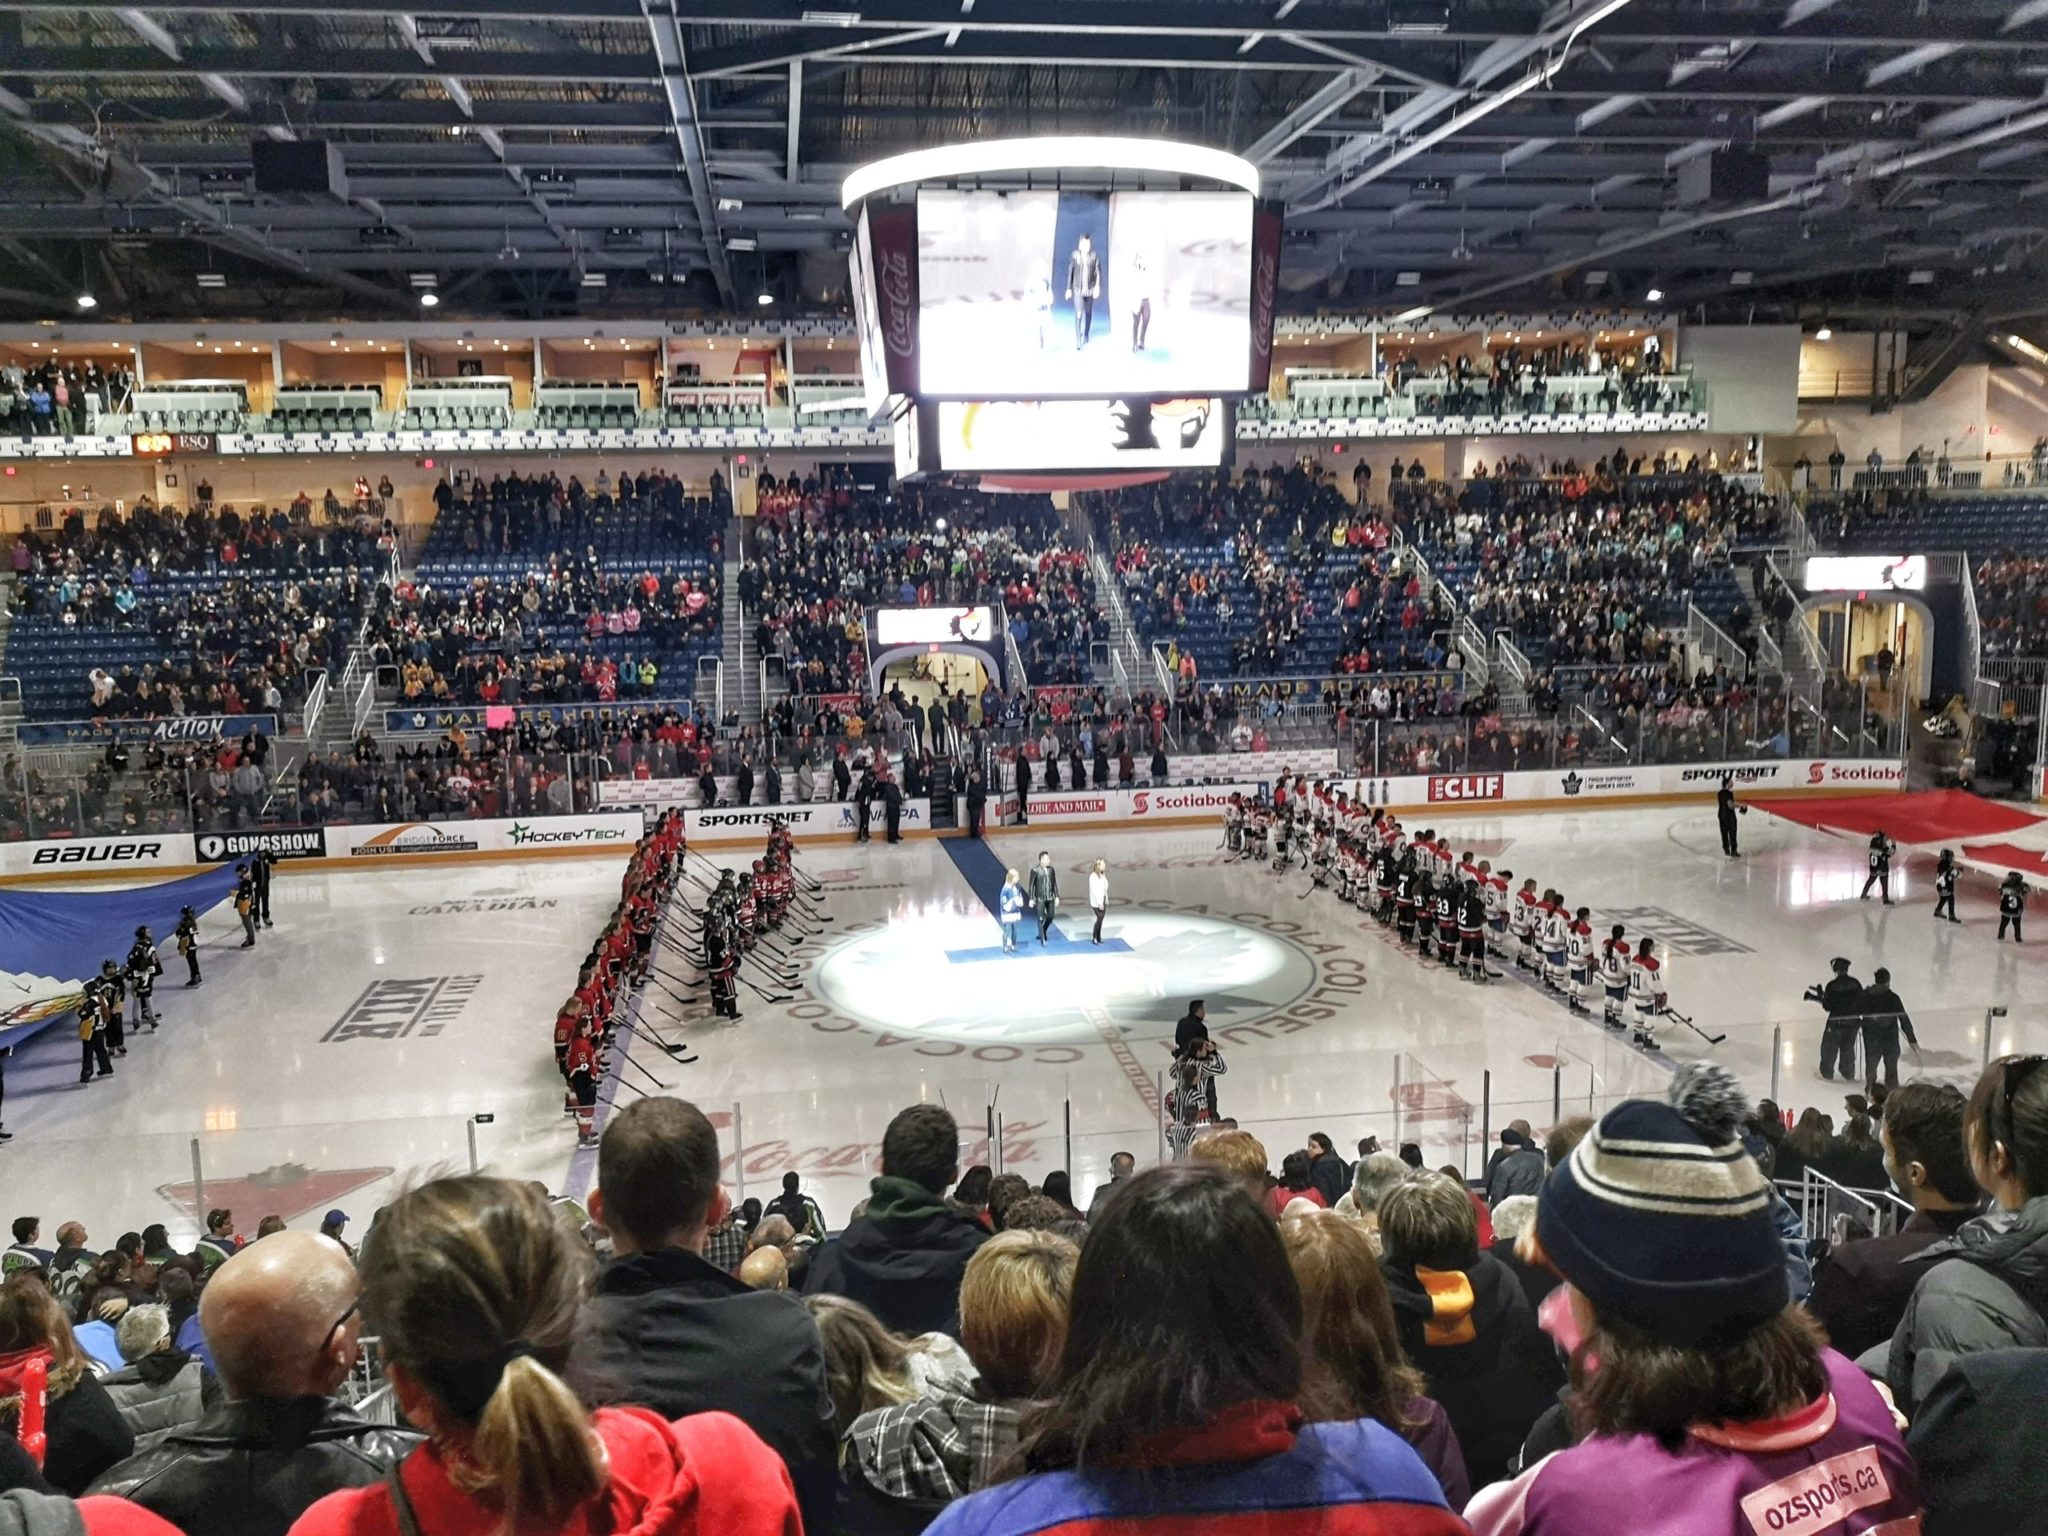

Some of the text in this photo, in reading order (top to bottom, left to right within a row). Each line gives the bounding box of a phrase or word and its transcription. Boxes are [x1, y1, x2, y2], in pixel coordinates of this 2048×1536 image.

[180, 434, 209, 449] ESQ
[67, 718, 225, 741] MADE FOR ACTION
[1682, 765, 1780, 782] SPORTSNET
[1444, 776, 1499, 799] CLIF
[870, 808, 919, 822] NHPA
[1052, 802, 1073, 813] AND
[1074, 801, 1099, 812] MAIL
[699, 810, 813, 827] SPORTSNET
[227, 833, 320, 854] GONGSHOW
[408, 900, 559, 916] CANADIAN
[1764, 1465, 1879, 1530] ozsports.ca
